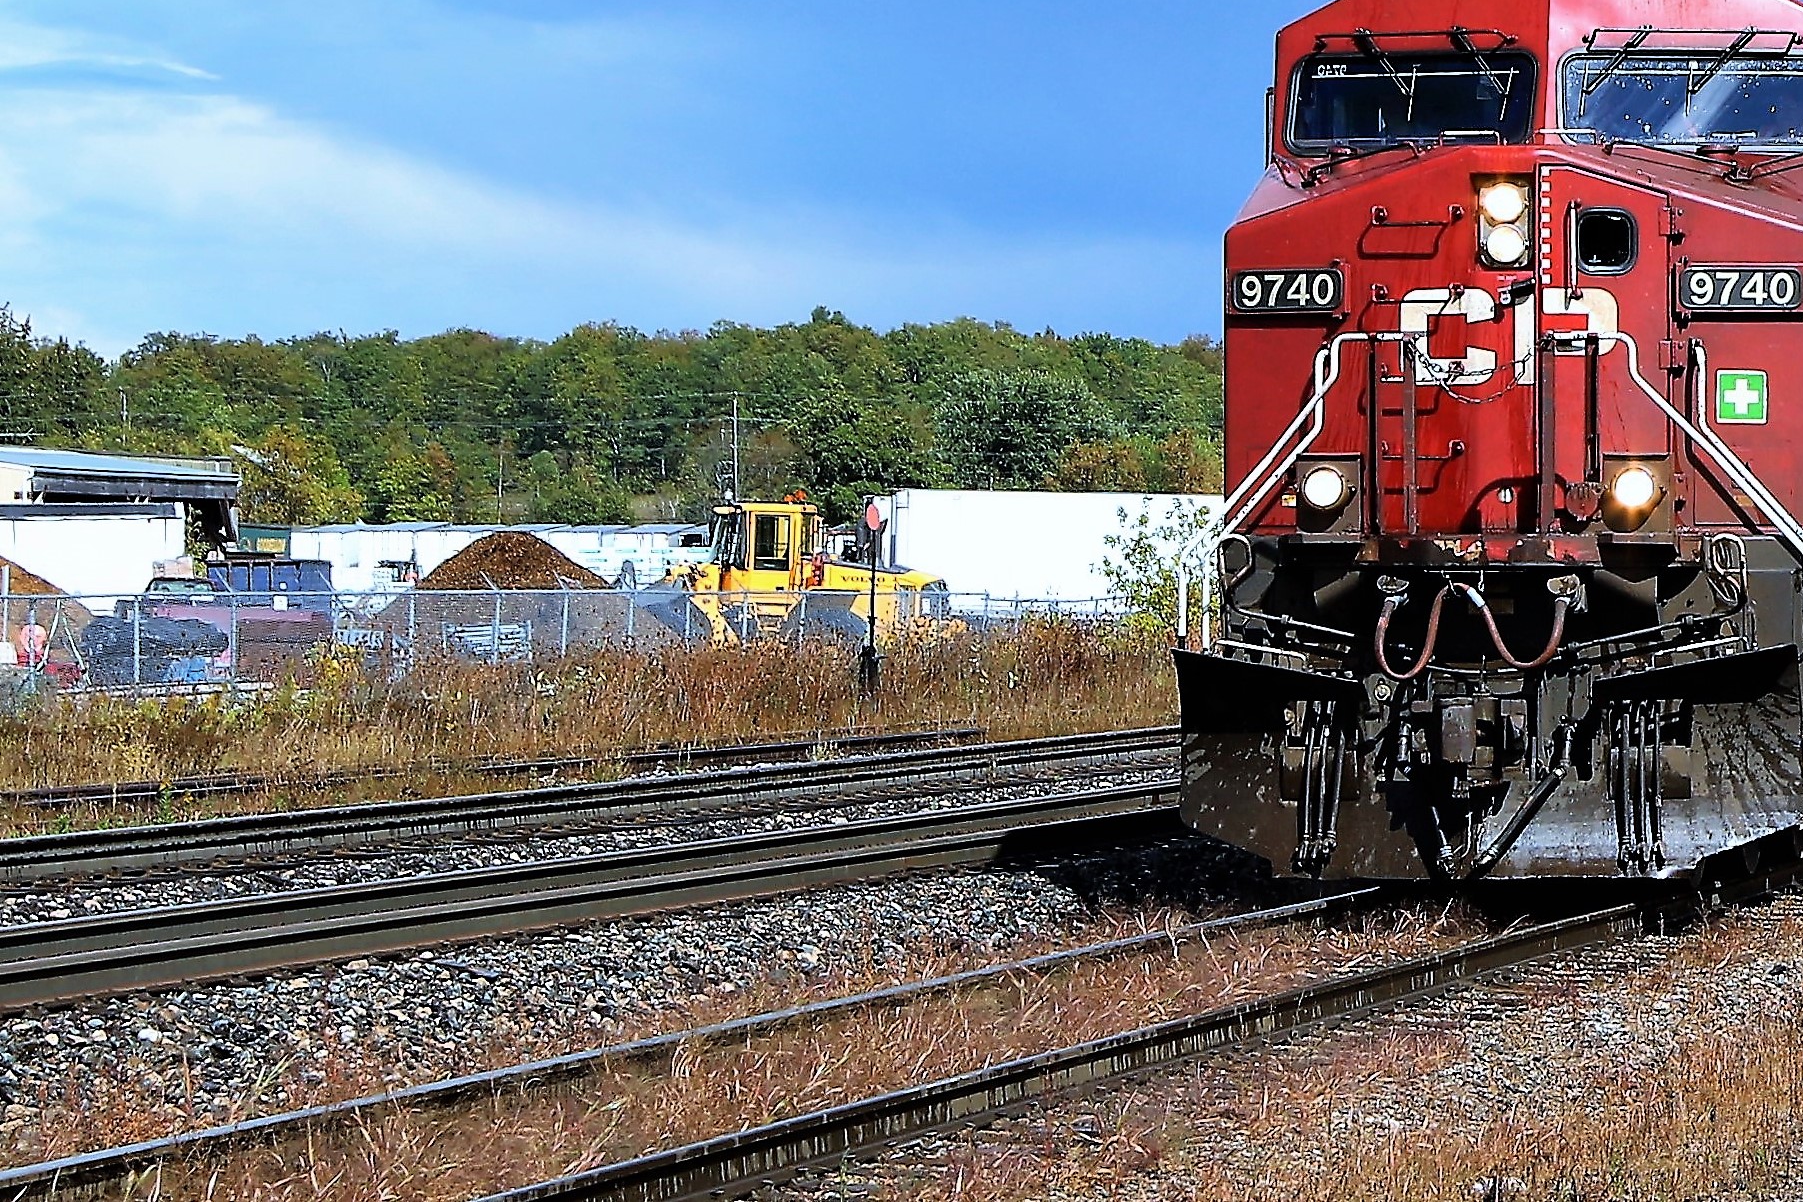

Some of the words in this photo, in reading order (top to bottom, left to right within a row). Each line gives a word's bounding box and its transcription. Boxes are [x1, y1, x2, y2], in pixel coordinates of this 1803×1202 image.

[1241, 274, 1334, 307] 9740
[1689, 272, 1794, 305] 9740
[1400, 287, 1618, 385] CP
